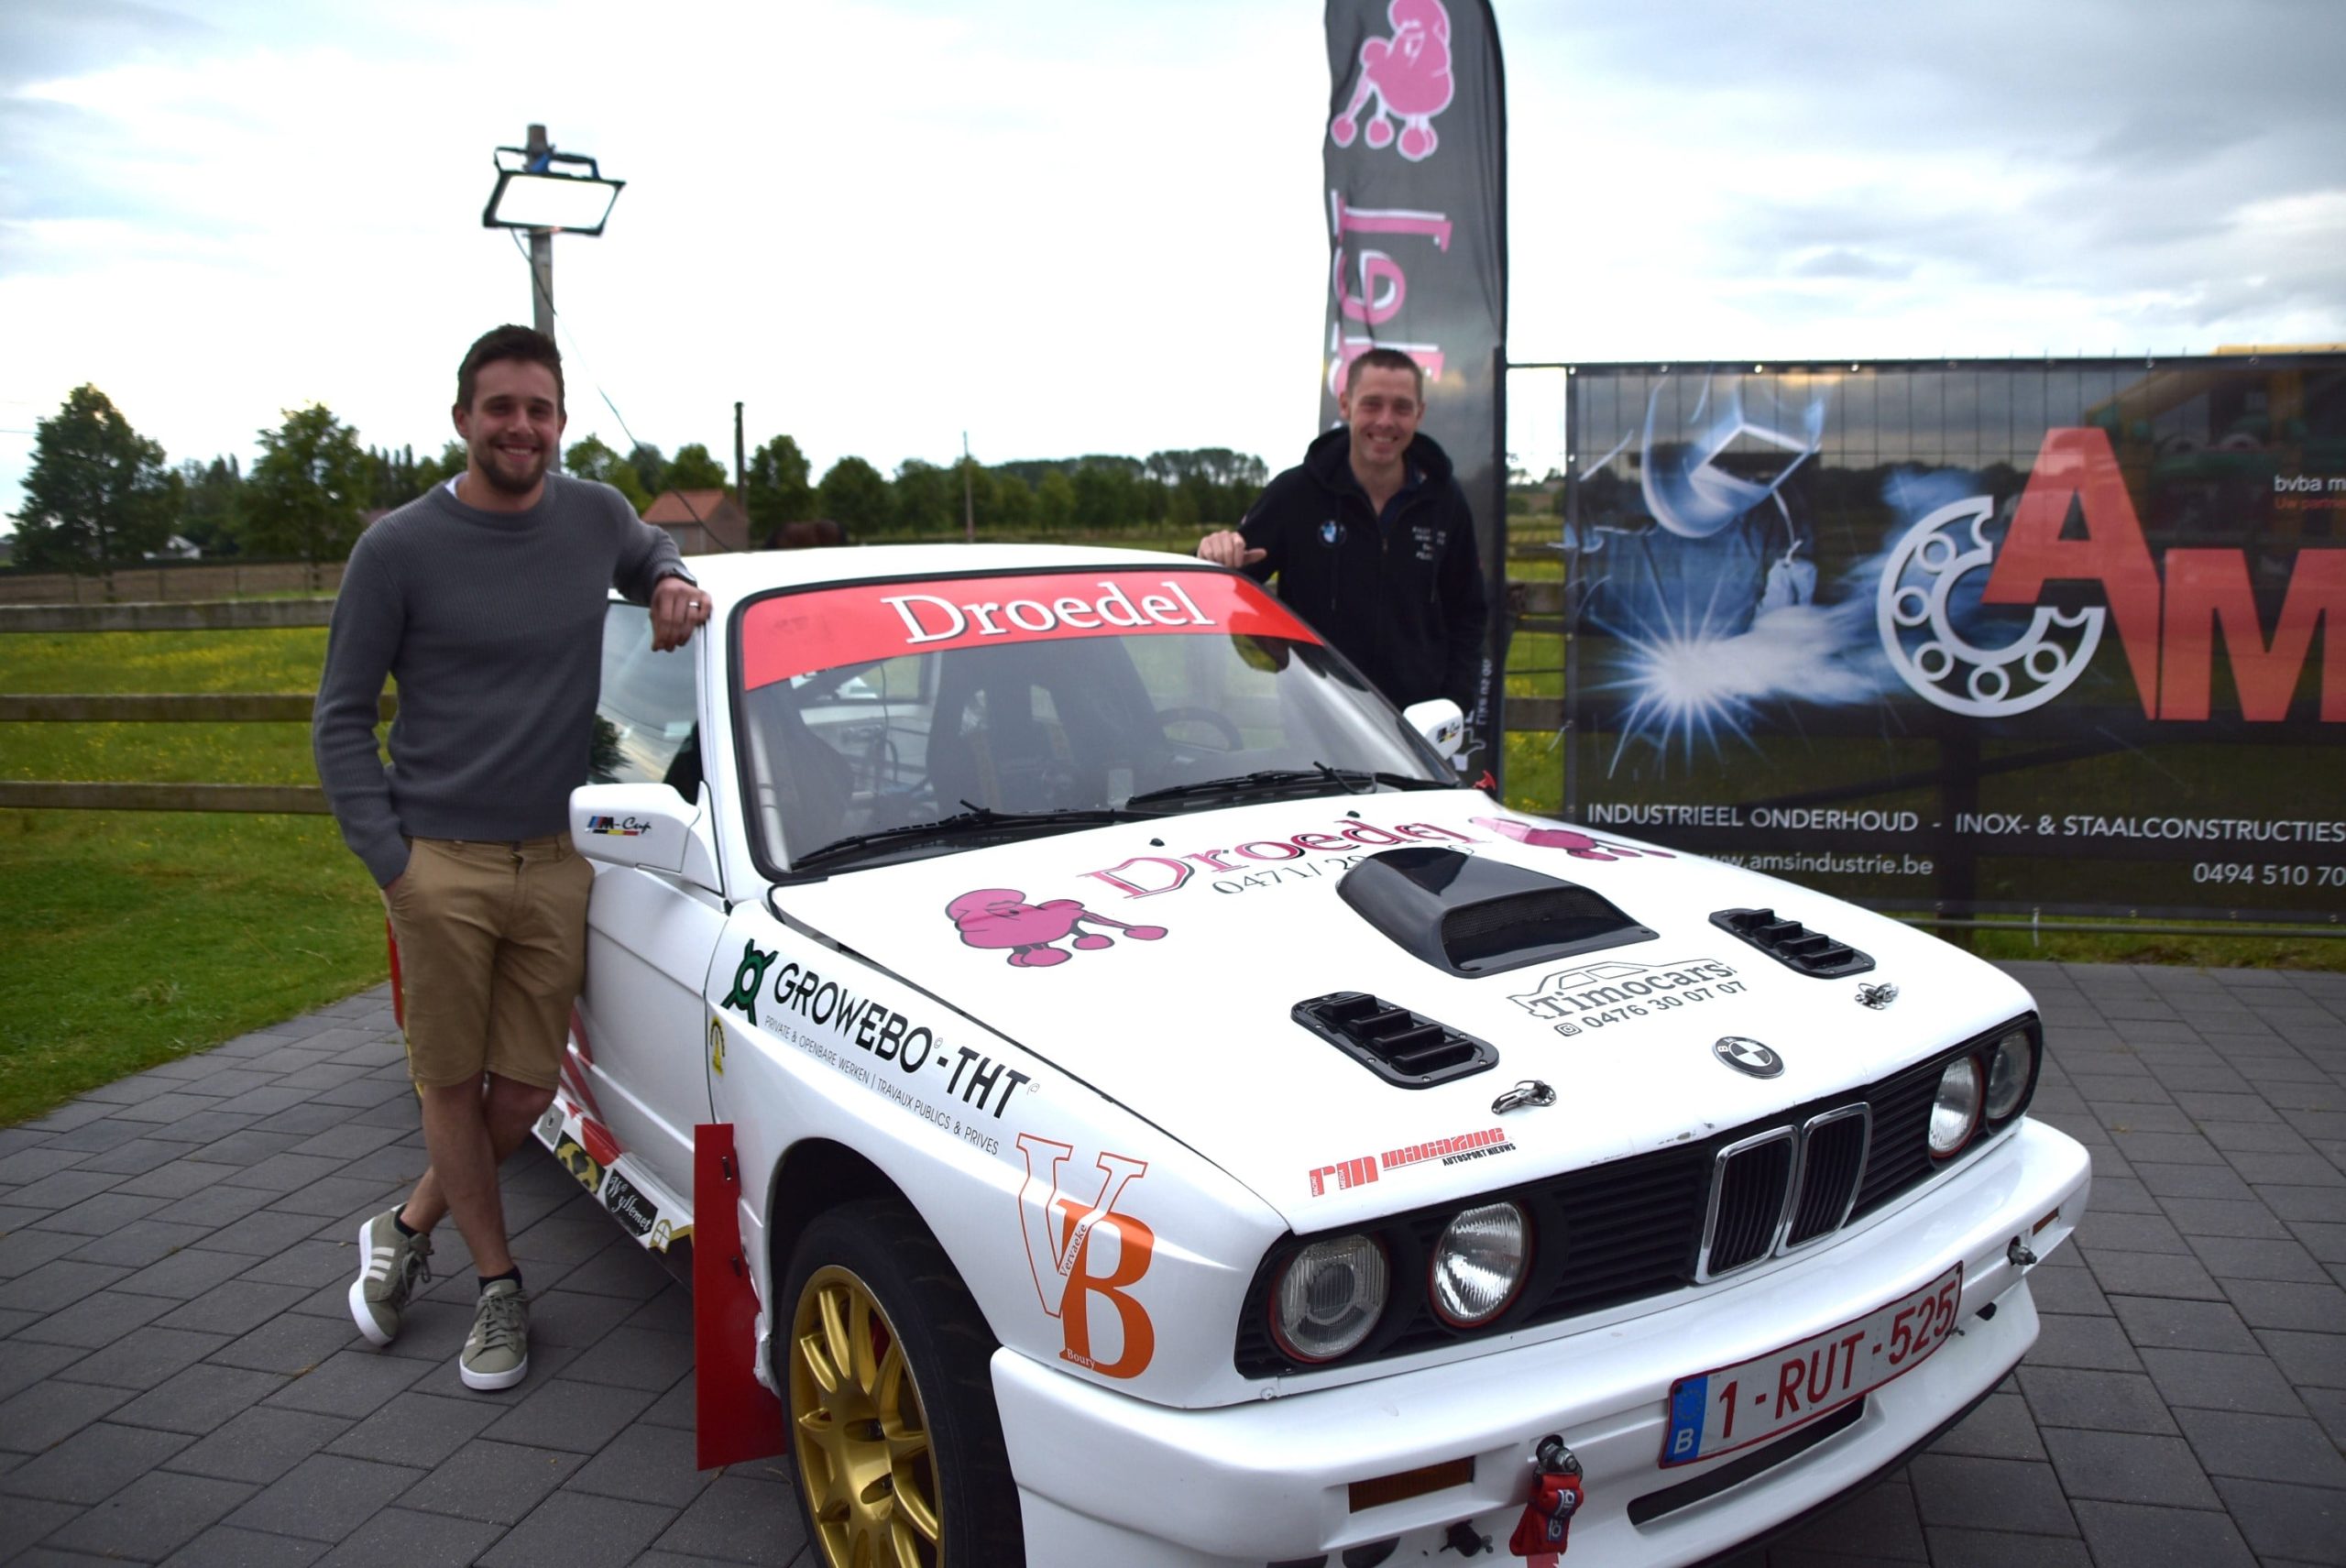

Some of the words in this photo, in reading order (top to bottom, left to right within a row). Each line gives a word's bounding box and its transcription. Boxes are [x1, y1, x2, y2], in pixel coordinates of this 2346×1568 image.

[2275, 475, 2323, 491] bvba
[881, 581, 1217, 644] Droedel
[1587, 804, 1744, 827] INDUSTRIEEL
[1749, 807, 1919, 832] ONDERHOUD
[1955, 813, 2030, 835] INOX-
[2036, 815, 2055, 835] &
[2064, 815, 2346, 842] STAALCONSTRUCTIES
[1077, 819, 1493, 900] Droedel
[1710, 852, 1934, 875] w.amsindustrie.be
[2193, 862, 2255, 883] 0494
[2262, 864, 2309, 886] 510
[2317, 866, 2346, 886] 70
[1529, 963, 1733, 1018] Timocars
[1582, 1004, 1649, 1028] 0476
[1648, 996, 1684, 1011] 30
[1683, 988, 1715, 1003] 07
[1716, 981, 1748, 994] 07
[764, 1015, 790, 1040] PRIVATE
[791, 1030, 797, 1043] &
[798, 1035, 838, 1068] OPENBARE
[838, 1055, 870, 1084] WERKEN
[877, 1078, 914, 1110] TRAVAUX
[915, 1102, 950, 1130] PUBLICS
[953, 1121, 961, 1136] &
[964, 1126, 999, 1157] PRIVES
[1381, 1127, 1507, 1168] magazine
[1442, 1149, 1486, 1167] AUTOSPORT
[1488, 1142, 1518, 1157] NIEUWS
[1059, 1223, 1088, 1278] Vervaeke
[1067, 1347, 1096, 1370] Boury
[1673, 1428, 1694, 1455] B
